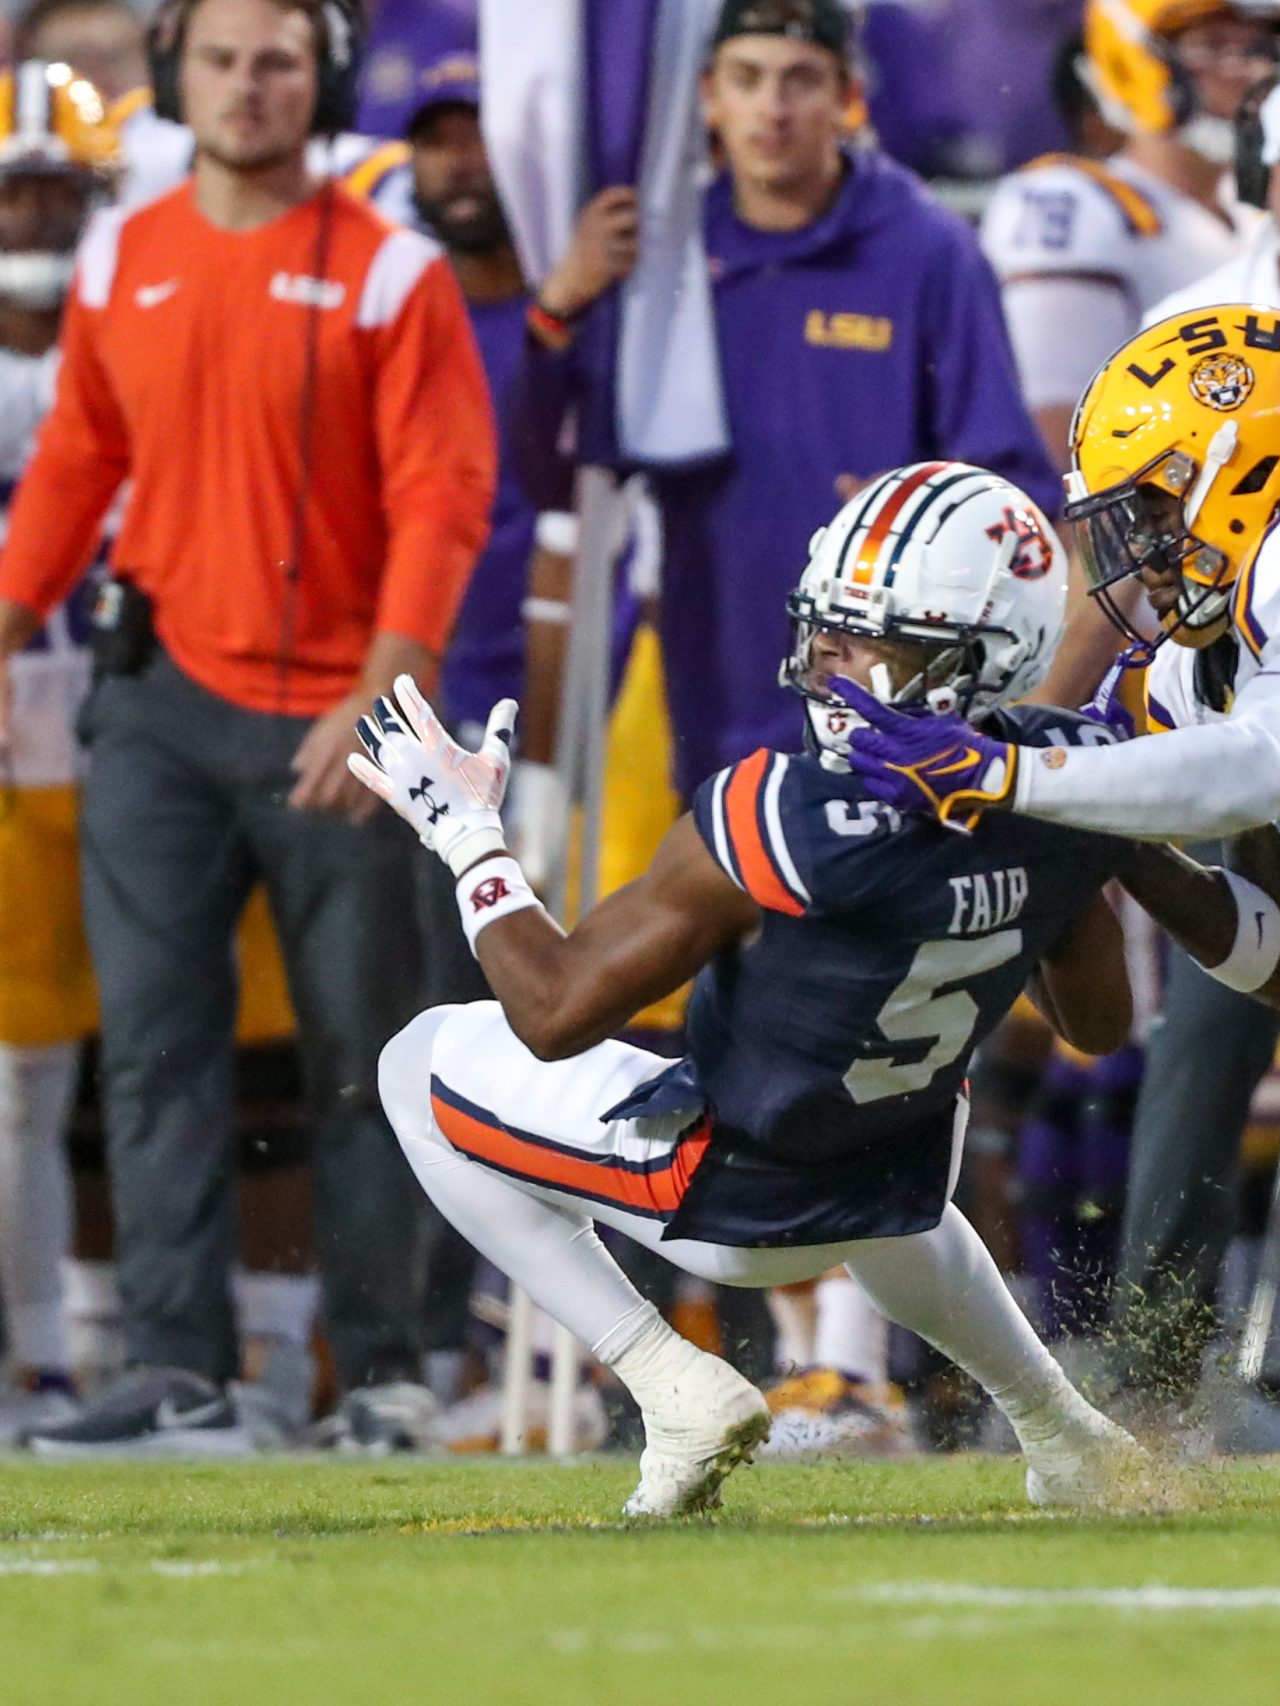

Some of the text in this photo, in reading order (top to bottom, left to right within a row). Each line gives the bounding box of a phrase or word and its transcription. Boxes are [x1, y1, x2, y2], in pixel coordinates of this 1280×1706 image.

[805, 308, 893, 352] LSU
[947, 866, 1029, 935] FAIR
[841, 928, 1023, 1105] 5
